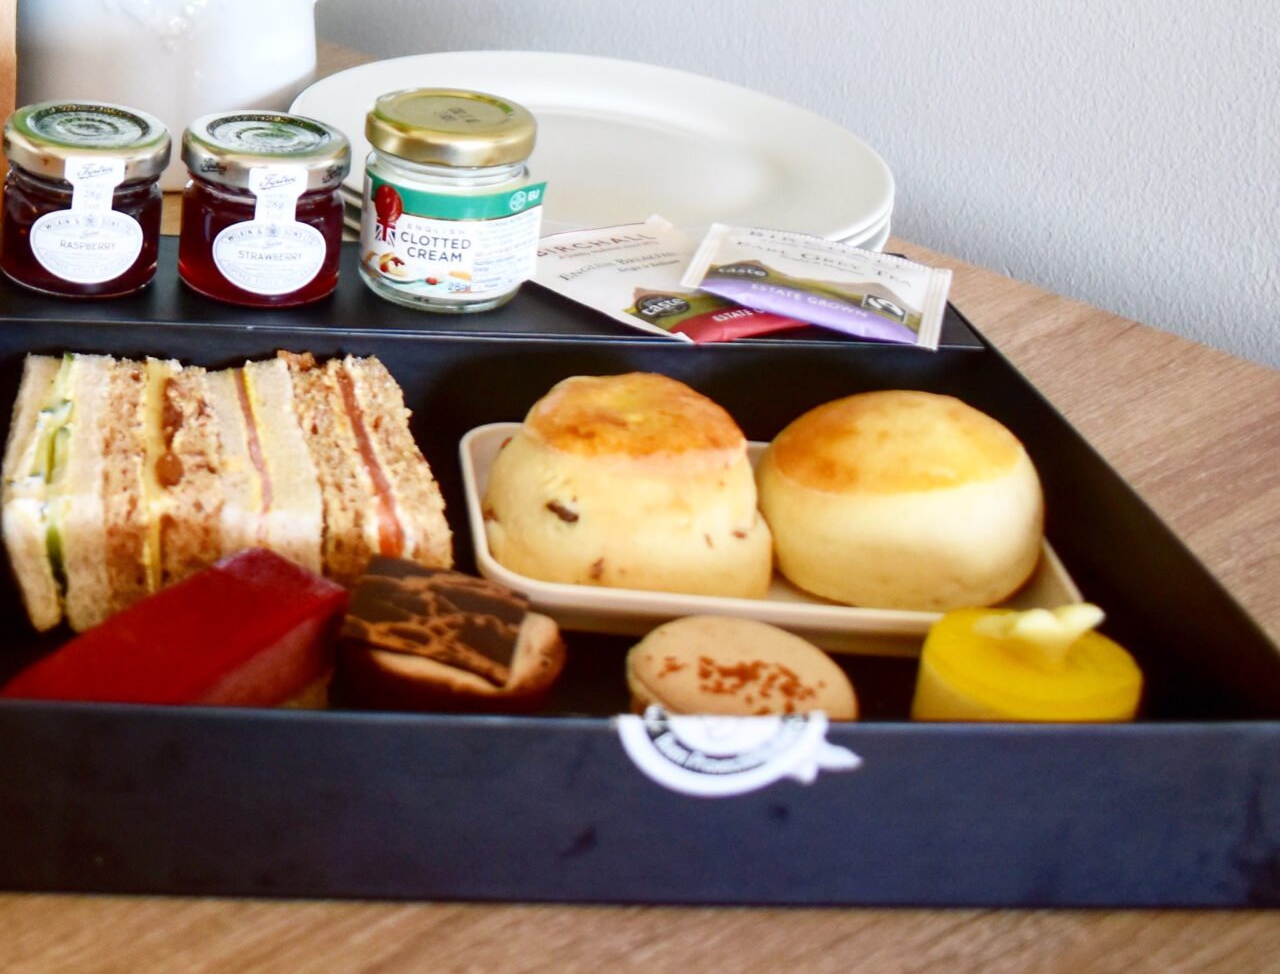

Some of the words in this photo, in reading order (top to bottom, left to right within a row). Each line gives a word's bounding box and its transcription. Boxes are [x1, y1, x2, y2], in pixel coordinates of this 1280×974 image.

[406, 223, 466, 236] ENGLISH
[60, 239, 116, 251] RASPBERRY
[400, 231, 472, 250] CLOTTED
[238, 250, 303, 262] STRAWBERRY
[407, 246, 463, 263] CREAM
[559, 260, 614, 281] ENGLISH
[718, 266, 768, 277] taste
[640, 296, 687, 316] taste
[751, 282, 802, 302] ESTATE
[807, 296, 868, 319] GROWN
[712, 308, 753, 323] ESTATE
